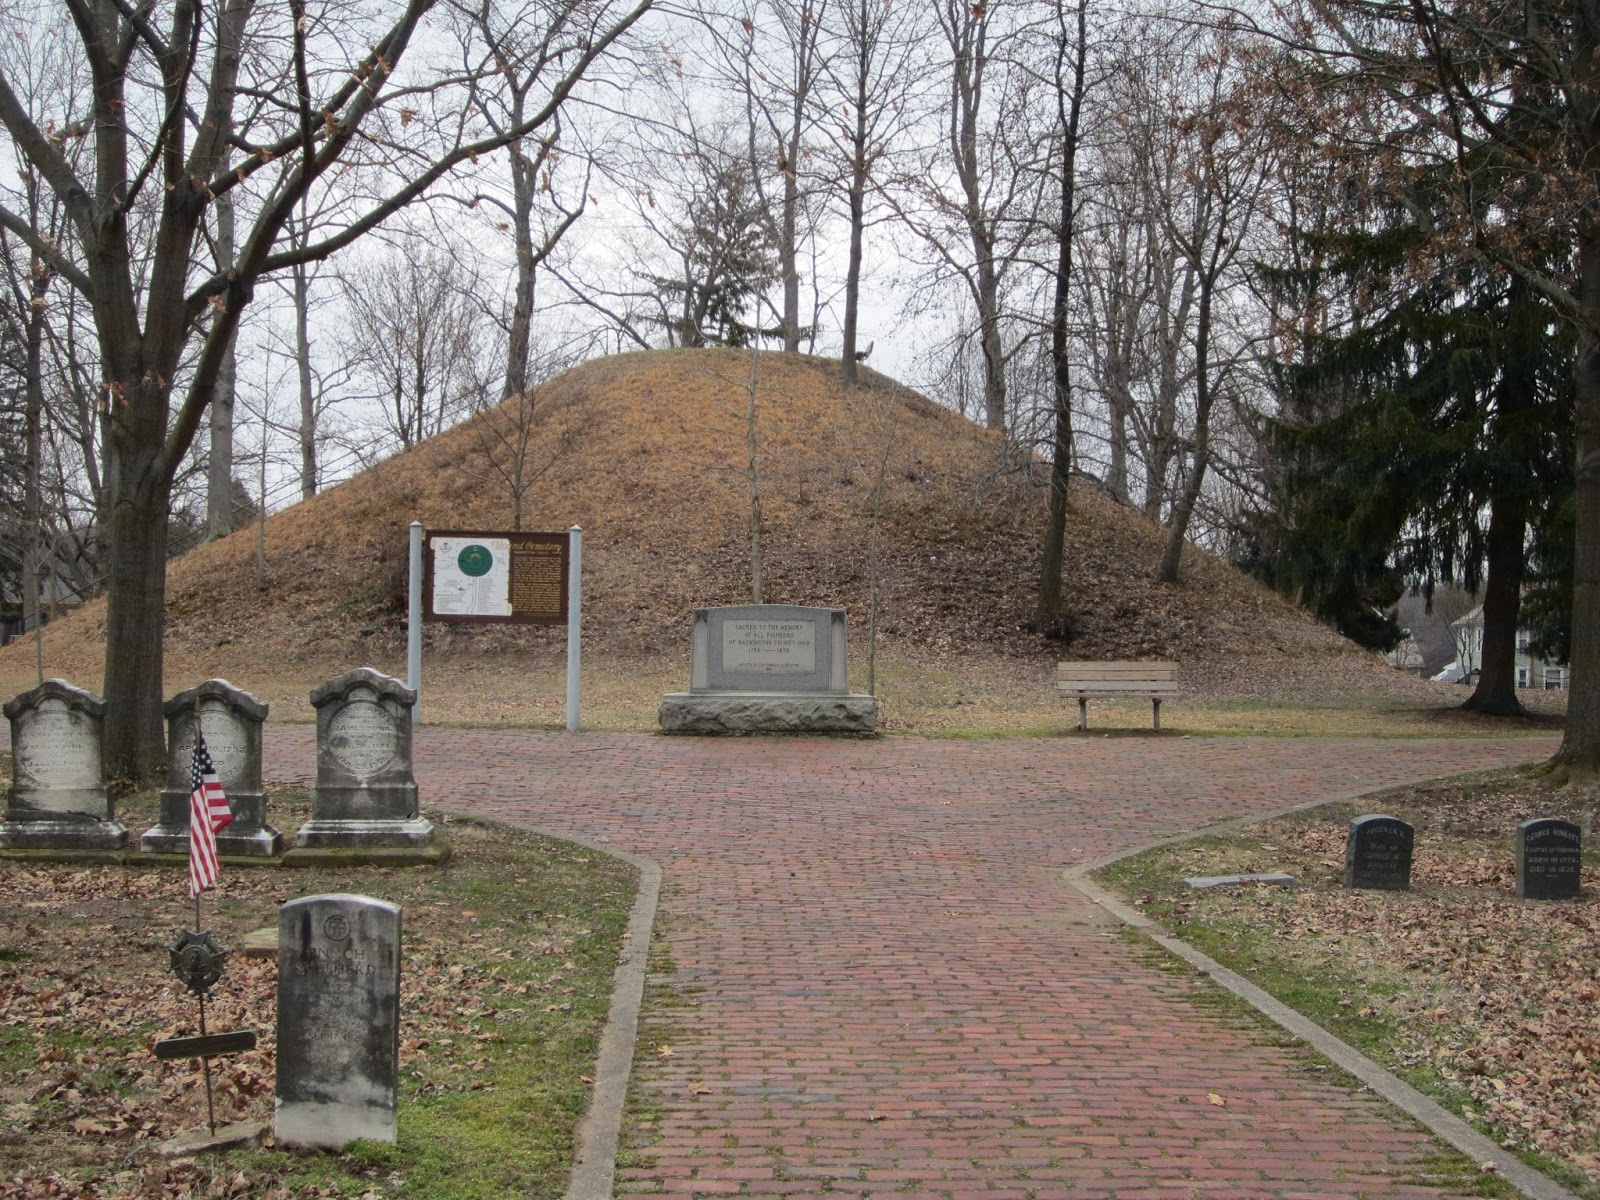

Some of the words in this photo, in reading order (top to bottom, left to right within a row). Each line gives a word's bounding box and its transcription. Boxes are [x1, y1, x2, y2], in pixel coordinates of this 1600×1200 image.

[526, 540, 563, 554] Cemetery
[1526, 828, 1550, 841] GEORGE
[1529, 865, 1545, 873] DIED
[309, 947, 366, 961] ENOCH
[295, 962, 377, 977] SHEPHERD
